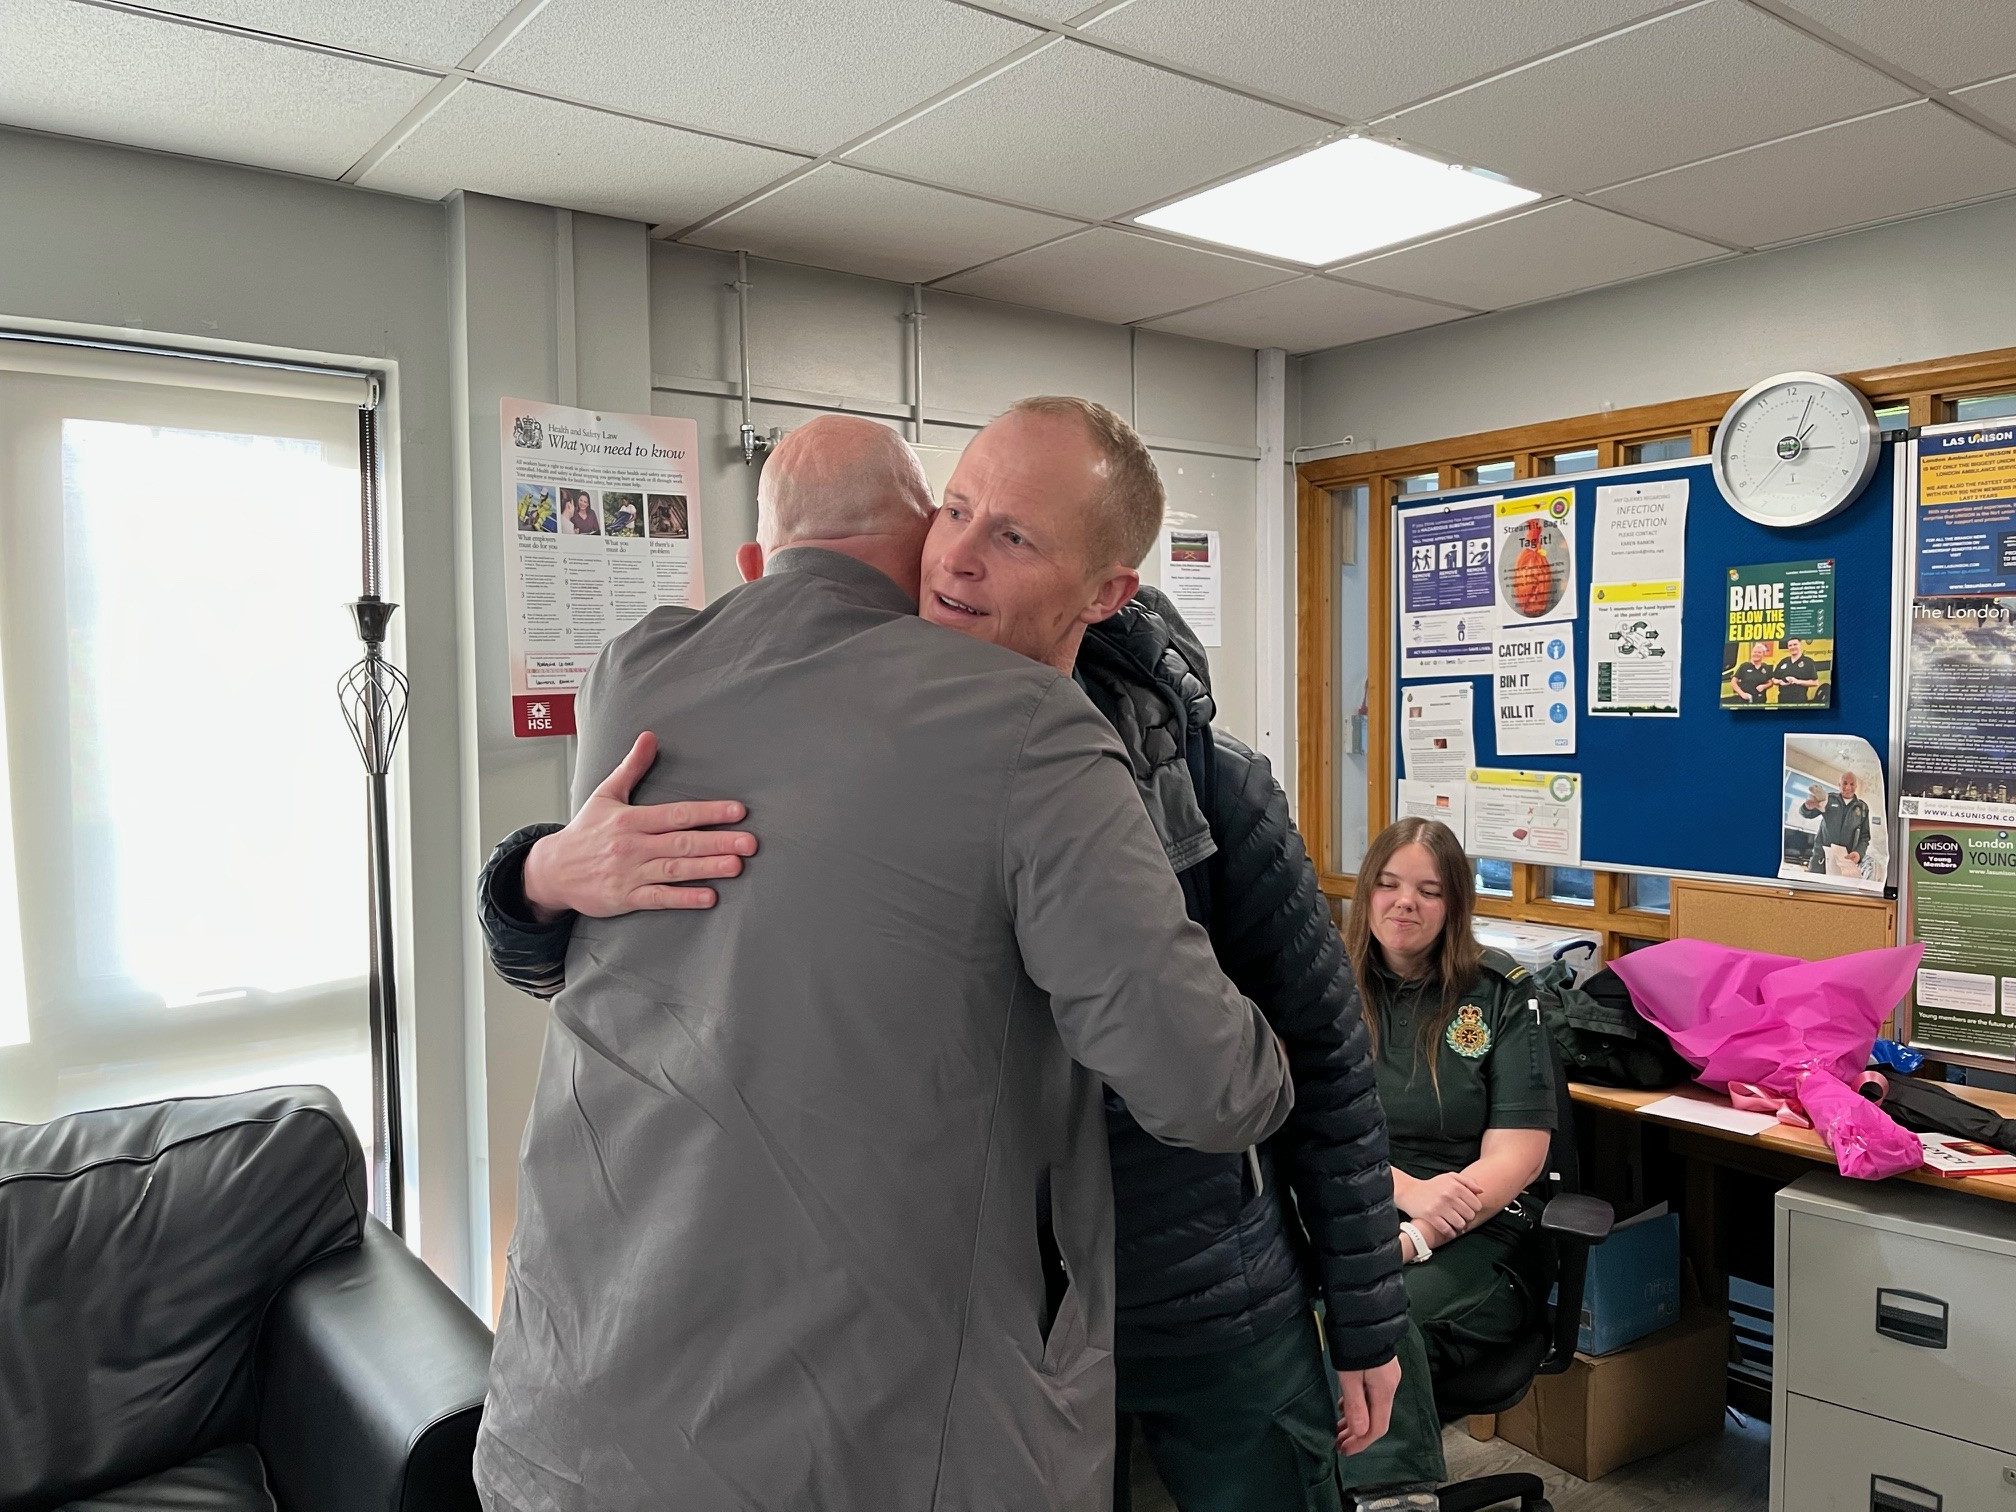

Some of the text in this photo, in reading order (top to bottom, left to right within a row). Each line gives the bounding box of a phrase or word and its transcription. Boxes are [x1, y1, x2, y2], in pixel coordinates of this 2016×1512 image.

[1787, 388, 1797, 396] 12
[1820, 391, 1826, 399] 1
[1757, 398, 1769, 409] 11
[1841, 409, 1849, 418] 2
[548, 424, 569, 434] Health
[583, 429, 600, 439] Safety
[602, 431, 618, 440] Law
[1737, 422, 1748, 433] 10
[1942, 431, 2013, 447] LAS UNISON
[548, 434, 686, 459] What you need to know
[1984, 449, 2011, 457] UNISON
[1971, 459, 1996, 467] BIGGEST
[1961, 466, 1996, 474] AMBULANCE
[1739, 480, 1747, 488] 8
[1616, 503, 1664, 515] INFECTION
[1503, 518, 1568, 534] Stream it, Bag it,
[1610, 517, 1668, 530] PREVENTION
[1519, 533, 1552, 549] Tag it!
[1730, 583, 1784, 612] BARE
[1729, 611, 1764, 624] BELOW
[1765, 609, 1784, 622] THE
[1912, 604, 2010, 619] The London
[1728, 623, 1786, 642] ELBOWS
[1498, 641, 1544, 658] CATCH IT
[1500, 674, 1530, 688] BIN IT
[1501, 705, 1534, 719] KILL IT
[528, 718, 552, 730] HSE
[1924, 809, 2015, 822] WWW.LASUNISON.CO
[1919, 842, 1958, 851] UNISON
[1968, 838, 2014, 849] London
[1969, 851, 2016, 867] YOUNG
[1919, 1012, 1937, 1021] Young
[1938, 1015, 1966, 1023] members
[1988, 1020, 2007, 1028] future
[1922, 1143, 1975, 1164] erci
